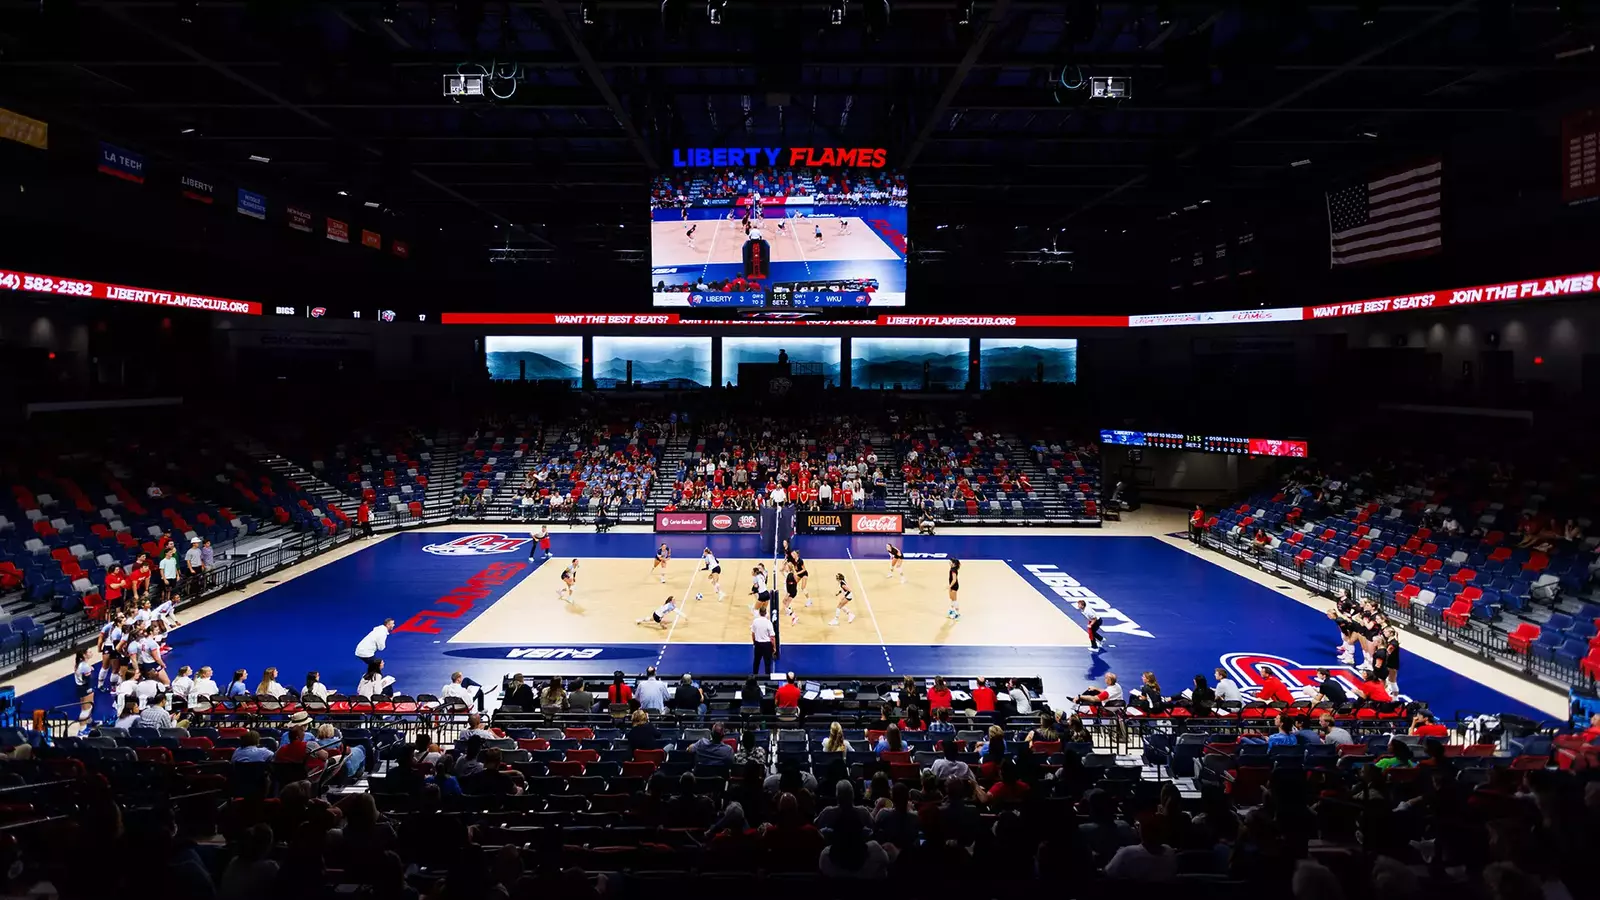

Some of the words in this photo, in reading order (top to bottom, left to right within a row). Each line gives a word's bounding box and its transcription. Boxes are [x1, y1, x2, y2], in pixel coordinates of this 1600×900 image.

[104, 150, 117, 163] LA
[119, 155, 143, 171] TECH
[672, 148, 781, 168] LIBERTY
[789, 148, 887, 168] FLAMES
[181, 175, 214, 193] LIBERTY
[23, 275, 93, 297] 582-2582
[106, 286, 249, 313] LIBERTYFLAMESCLUB.ORG
[1449, 288, 1482, 305] JOIN
[1484, 285, 1517, 301] THE
[1519, 275, 1594, 298] FLAMES
[276, 306, 295, 315] BIGS
[1313, 306, 1339, 319] WANT
[1341, 304, 1362, 315] THE
[1363, 299, 1389, 313] BEST
[1391, 294, 1436, 310] SEATS?
[555, 315, 583, 324] WANT
[585, 315, 606, 324] THE
[608, 315, 632, 324] BEST
[634, 315, 669, 324] SEATS?
[887, 316, 1017, 325] LIBERTYFLAMESCLUB.ORG
[807, 515, 842, 527] KUBOTA
[857, 515, 898, 531] Coca-Cola
[391, 561, 528, 635] FLAMES
[1022, 564, 1156, 639] LIBERTY
